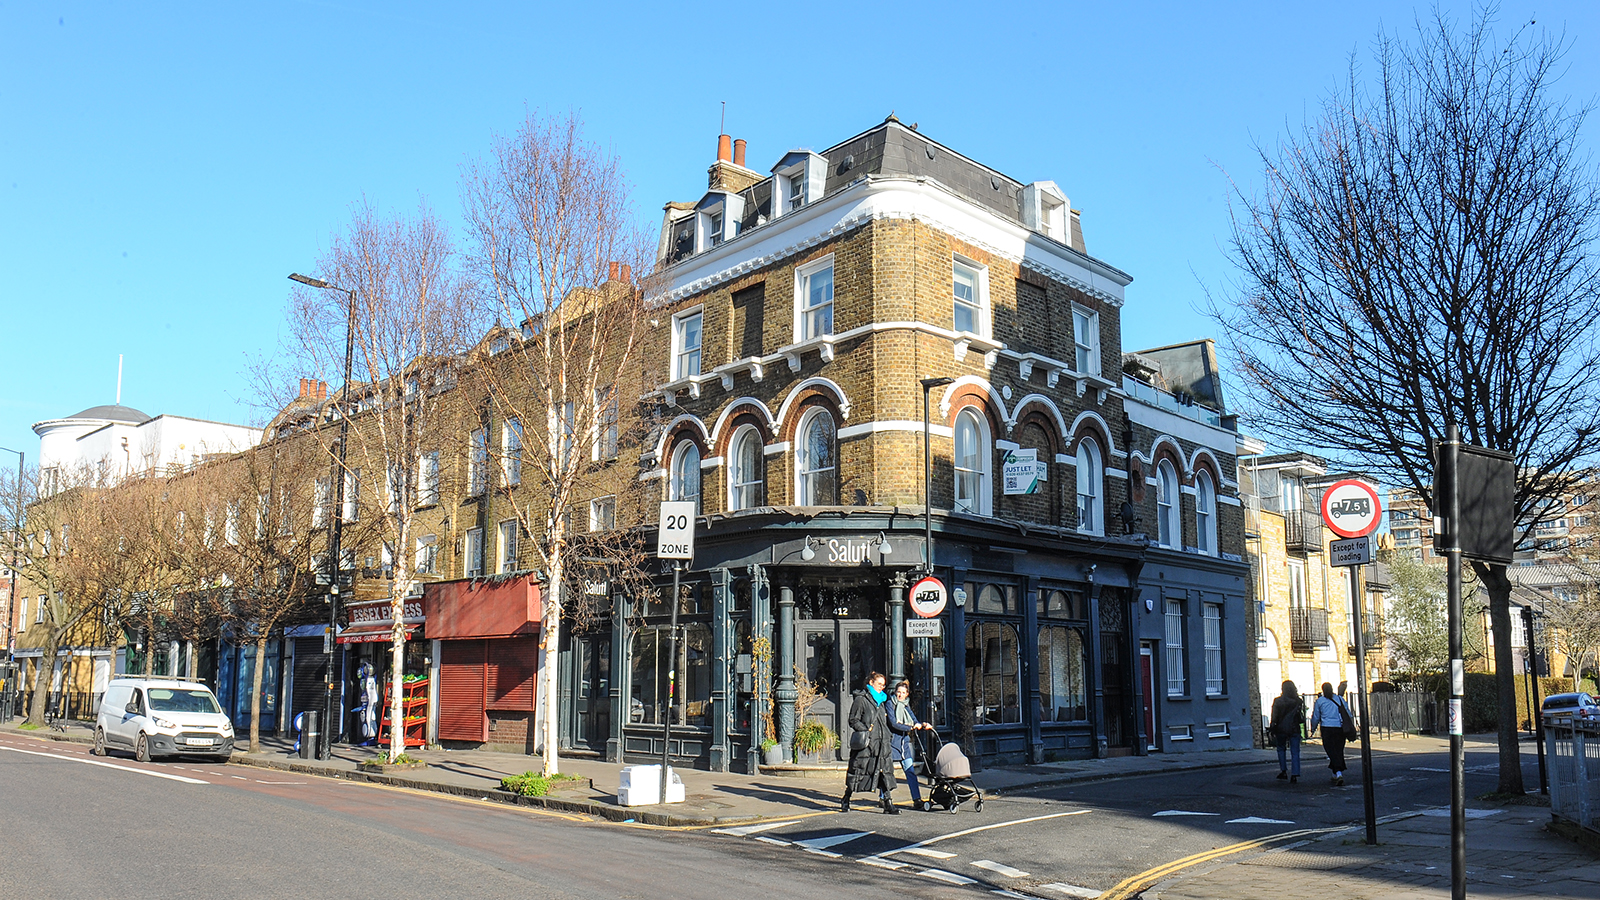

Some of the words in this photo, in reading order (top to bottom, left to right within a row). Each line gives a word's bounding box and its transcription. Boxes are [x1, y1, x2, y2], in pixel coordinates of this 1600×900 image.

[1343, 500, 1360, 511] 7.5
[666, 515, 688, 530] 20
[661, 544, 689, 554] ZONE
[1332, 543, 1355, 552] Except
[1337, 553, 1361, 561] loading
[353, 607, 381, 622] ESSEX
[381, 603, 422, 619] EXESS
[832, 607, 849, 616] 412
